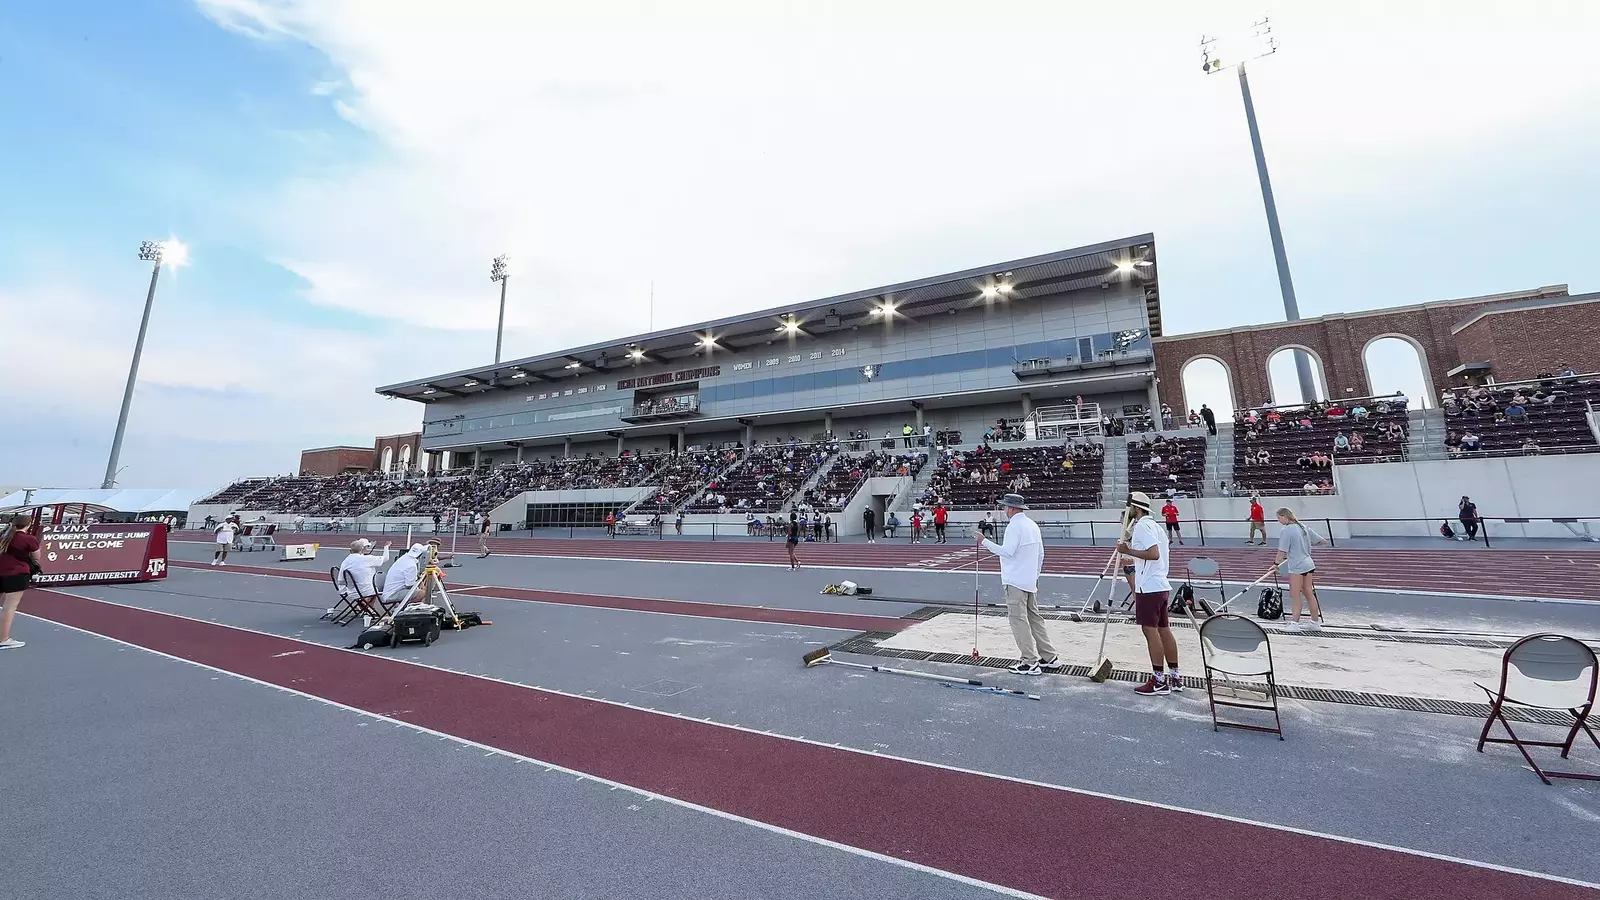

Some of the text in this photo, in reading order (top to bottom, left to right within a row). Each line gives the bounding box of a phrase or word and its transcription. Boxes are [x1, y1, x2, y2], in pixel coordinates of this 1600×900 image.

[832, 348, 846, 357] 2014
[637, 373, 673, 387] NATIONAL
[675, 365, 720, 381] CHAMPIONS
[53, 525, 90, 533] LYNX
[43, 533, 89, 541] WOMEN'S
[124, 531, 150, 539] JUMP
[45, 540, 124, 550] 1 WELCOME
[36, 571, 140, 583] TEXAS A&M UNIVERSITY
